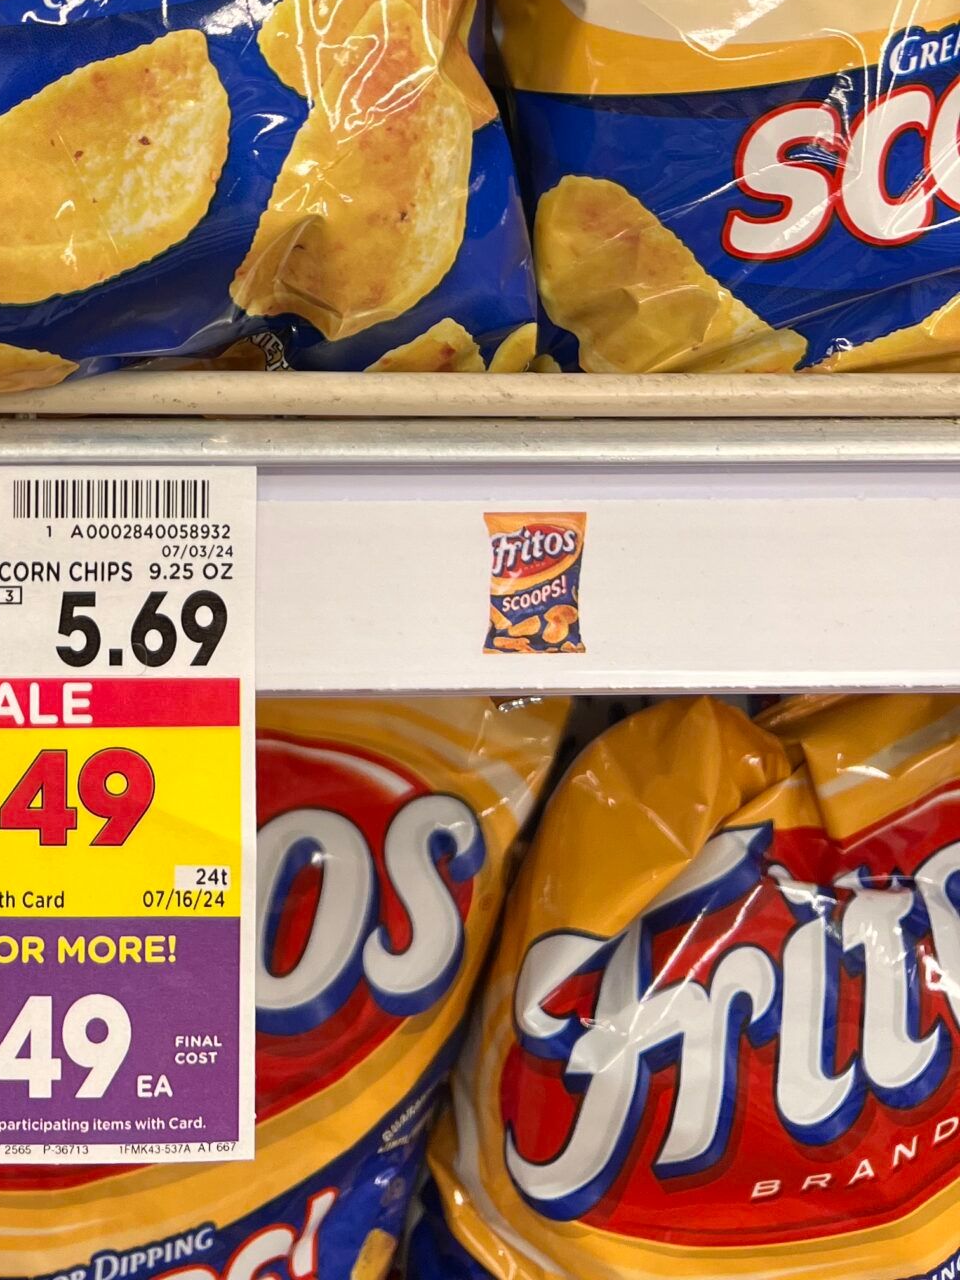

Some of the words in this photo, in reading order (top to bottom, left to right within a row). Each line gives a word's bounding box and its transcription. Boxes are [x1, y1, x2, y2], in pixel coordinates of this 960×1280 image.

[889, 30, 960, 76] GRE
[46, 525, 52, 538] 1
[161, 545, 234, 559] 07/03/24
[491, 526, 578, 577] Fritos
[69, 562, 133, 582] CHIPS
[149, 562, 194, 581] 9.25
[203, 562, 234, 581] OZ
[5, 590, 15, 602] 3
[502, 575, 566, 612] SCOOPS!
[55, 589, 228, 667] 5.69
[195, 868, 228, 886] 24t
[22, 890, 65, 909] Card
[142, 890, 226, 910] 07/16/24
[57, 935, 178, 964] MORE!
[175, 1035, 223, 1048] FINAL
[175, 1052, 218, 1064] COST
[138, 1075, 173, 1097] EA
[93, 1117, 132, 1131] items
[135, 1115, 166, 1130] with
[169, 1115, 206, 1130] Card.
[4, 1145, 31, 1155] 2565
[43, 1145, 89, 1155] P-36713
[216, 1142, 237, 1152] 667
[750, 1116, 959, 1200] BRAND
[93, 1227, 215, 1280] DIPPING
